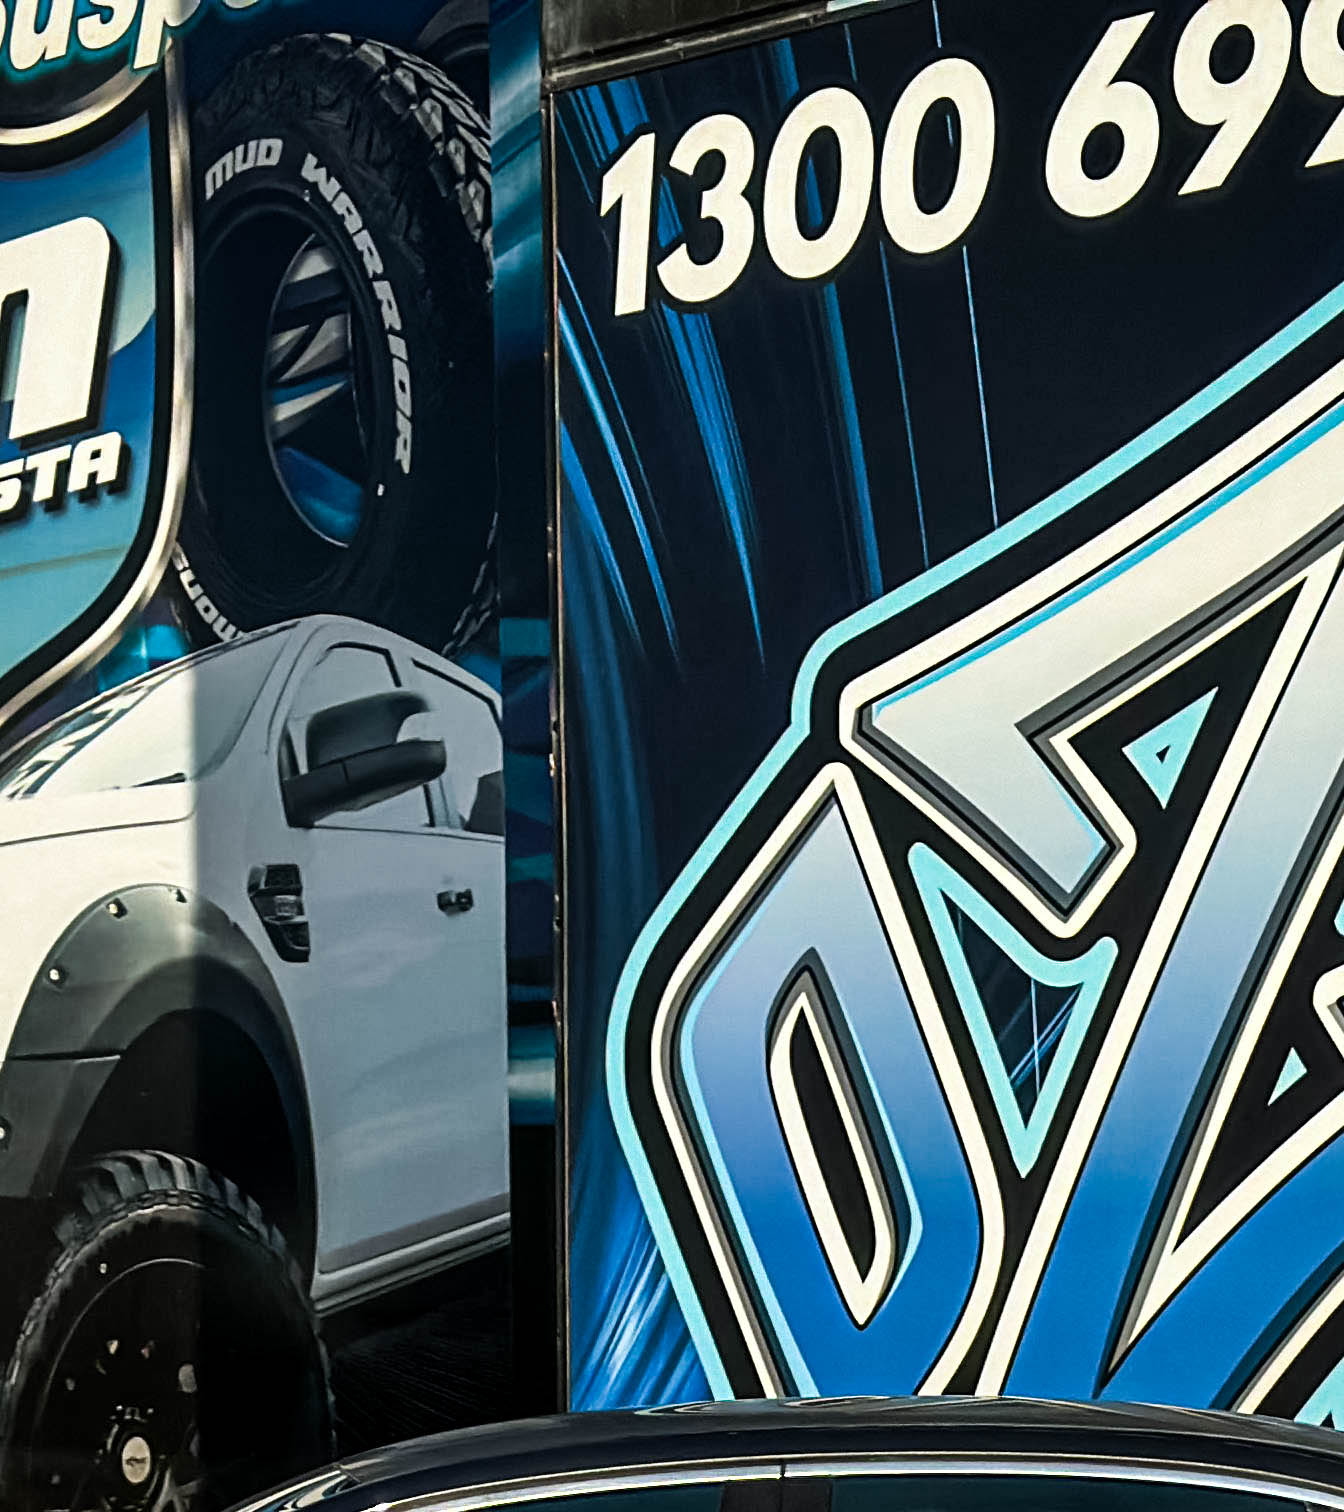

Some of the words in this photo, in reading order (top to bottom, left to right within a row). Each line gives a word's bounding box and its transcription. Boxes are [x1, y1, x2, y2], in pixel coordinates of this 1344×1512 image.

[205, 138, 283, 200] MUD
[301, 152, 412, 474] WARRIOR
[598, 56, 997, 317] 1300
